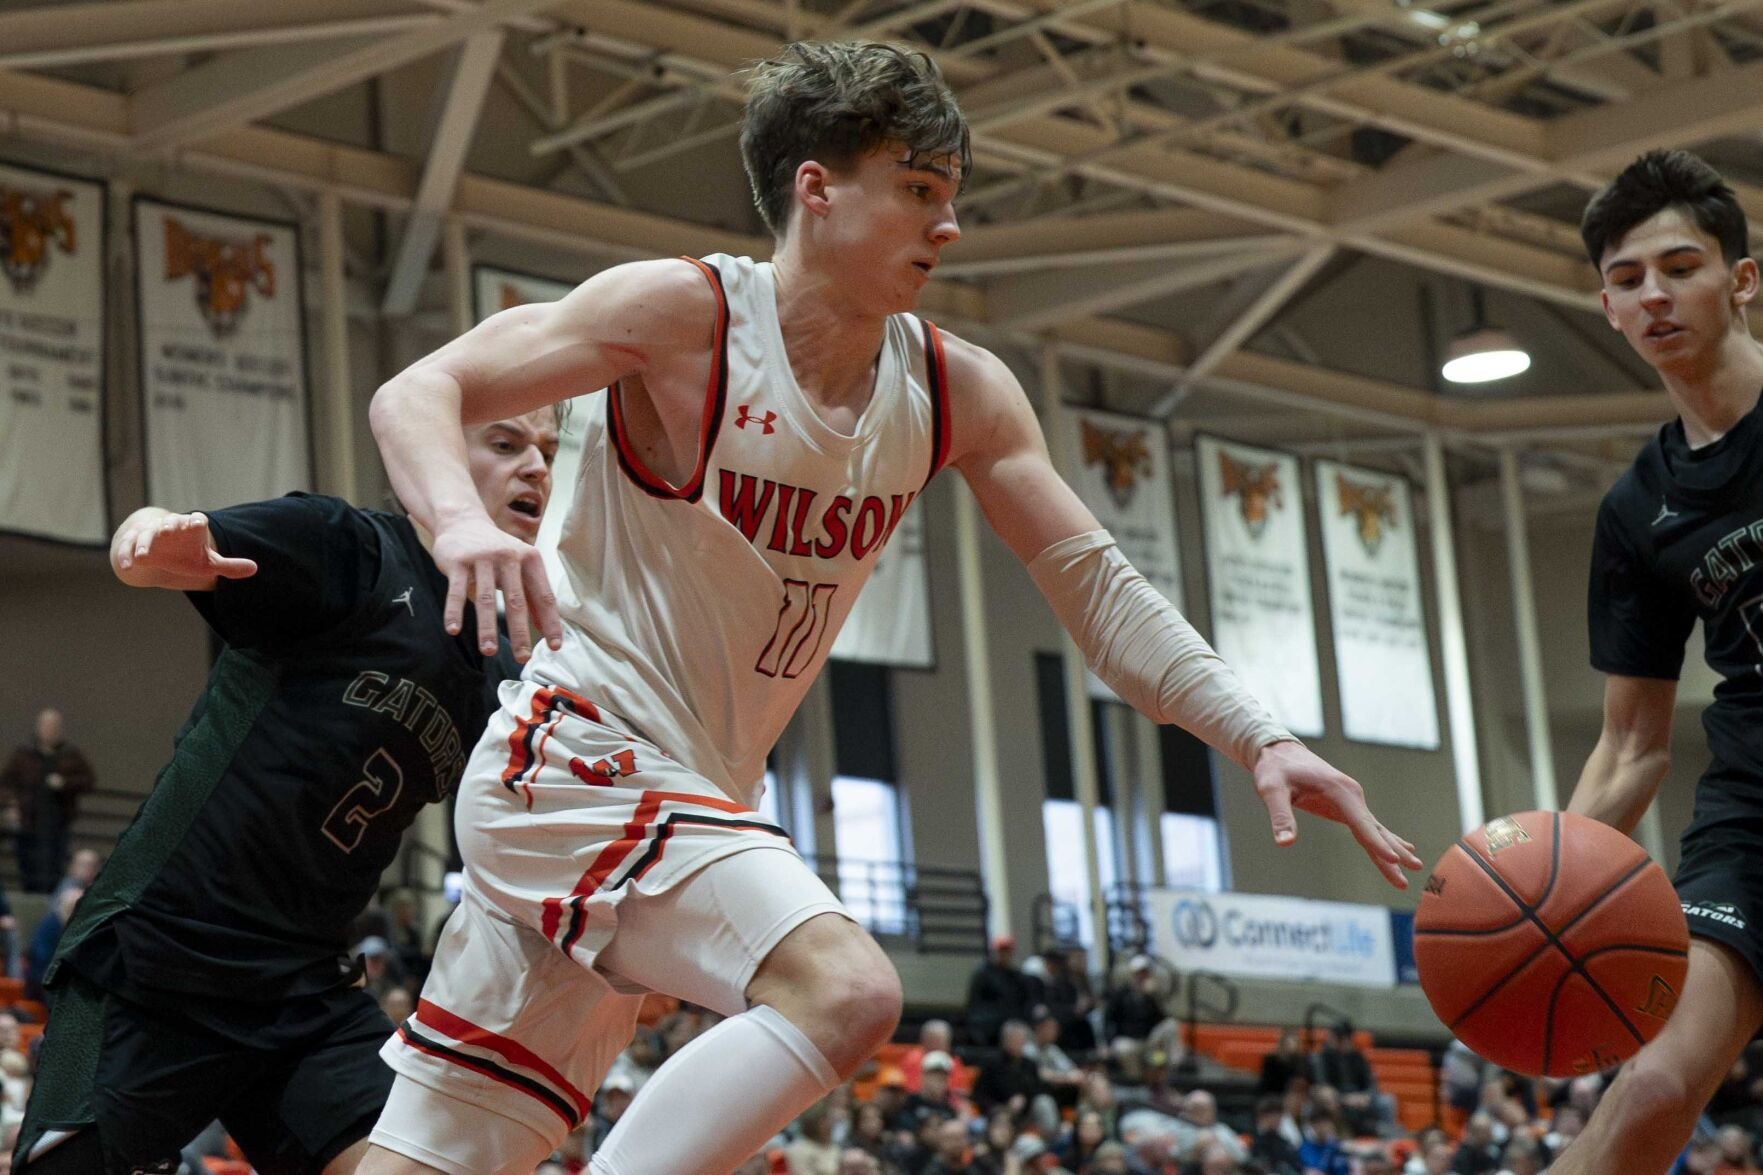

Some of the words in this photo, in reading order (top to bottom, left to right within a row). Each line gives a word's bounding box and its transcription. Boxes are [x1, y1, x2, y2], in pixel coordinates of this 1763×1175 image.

[718, 468, 917, 561] WILSON
[1690, 518, 1763, 610] GAT
[755, 578, 838, 678] 11
[341, 670, 467, 800] GATORS
[320, 747, 404, 855] 2
